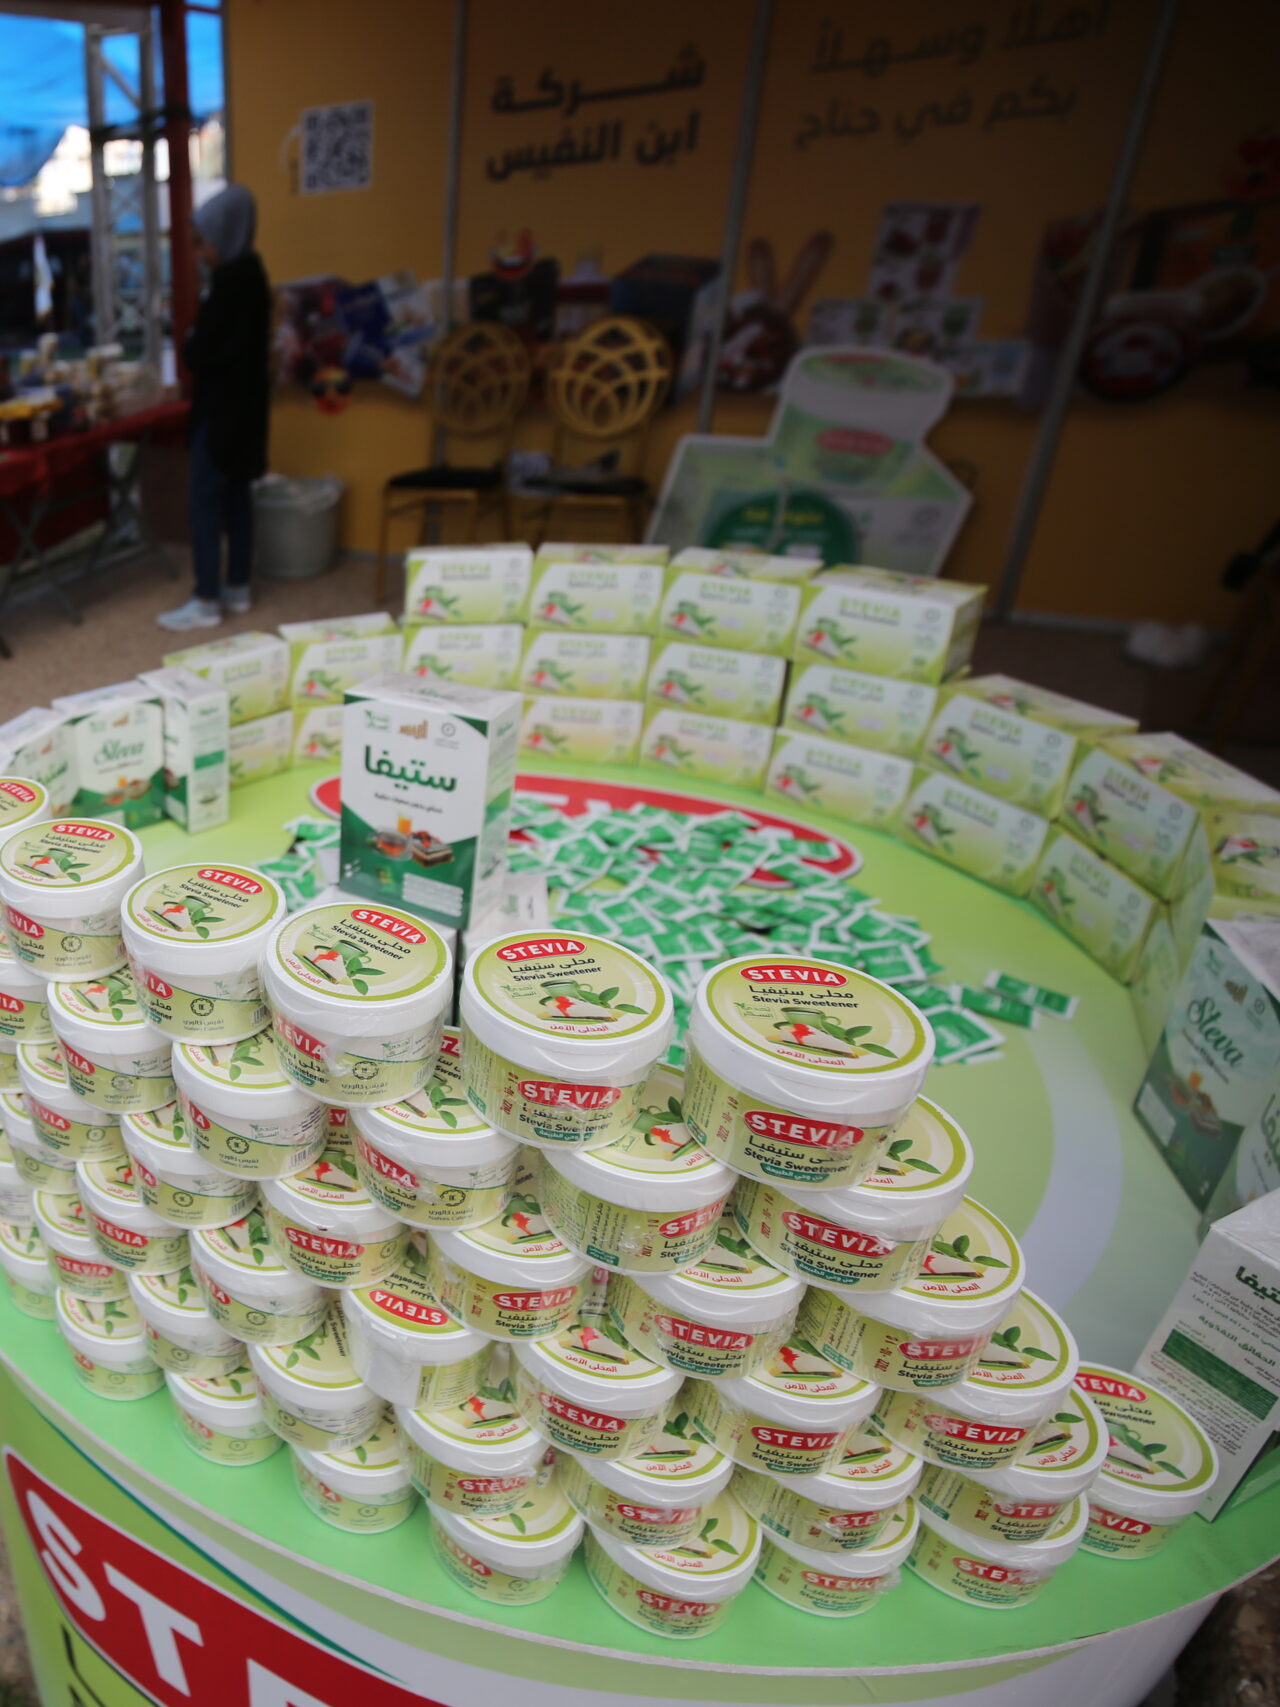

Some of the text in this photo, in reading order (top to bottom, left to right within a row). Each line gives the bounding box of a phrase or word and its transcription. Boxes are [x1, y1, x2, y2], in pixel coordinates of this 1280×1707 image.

[491, 43, 707, 116] شركة
[895, 89, 973, 142] في
[983, 74, 1078, 133] بكم
[486, 110, 700, 181] ابن النفيس
[365, 745, 457, 792] ستيفا
[1, 783, 34, 802] STEVIA
[56, 825, 111, 840] STEVIA
[200, 870, 261, 893] STEVIA
[179, 883, 242, 909] Stevia Sweetener
[356, 911, 423, 943] STEVIA
[331, 926, 404, 960] Stevia Sweetener
[502, 941, 581, 960] STEVIA
[513, 966, 602, 982] Stevia Sweetener
[747, 968, 842, 986] STEVIA
[752, 995, 859, 1009] Stevia Sweetener
[1187, 996, 1244, 1068] Steva
[524, 1083, 616, 1106] STEVIA
[520, 1114, 553, 1130] Stevia
[752, 1115, 857, 1146] STEVIA
[744, 1147, 849, 1173] Stevia Sweetener
[288, 1229, 360, 1257] STEVIA
[788, 1214, 887, 1255] STEVIA
[289, 1254, 360, 1276] Stevia Sweetener
[780, 1242, 880, 1279] Stevia Sweetener
[374, 1292, 443, 1323] STEVIA
[498, 1290, 573, 1308] STEVIA
[495, 1320, 525, 1329] Stevia
[659, 1317, 749, 1347] STEVIA
[898, 1370, 932, 1380] Stevia
[1076, 1376, 1142, 1400] TEVIA
[541, 1394, 619, 1430] STEVIA
[567, 1433, 618, 1449] Sweetener
[758, 1429, 839, 1448] STEVIA
[930, 1417, 1023, 1442] STEVIA
[751, 1451, 784, 1464] Stevia
[923, 1439, 958, 1458] Stevia
[991, 1524, 1023, 1535] Stevia
